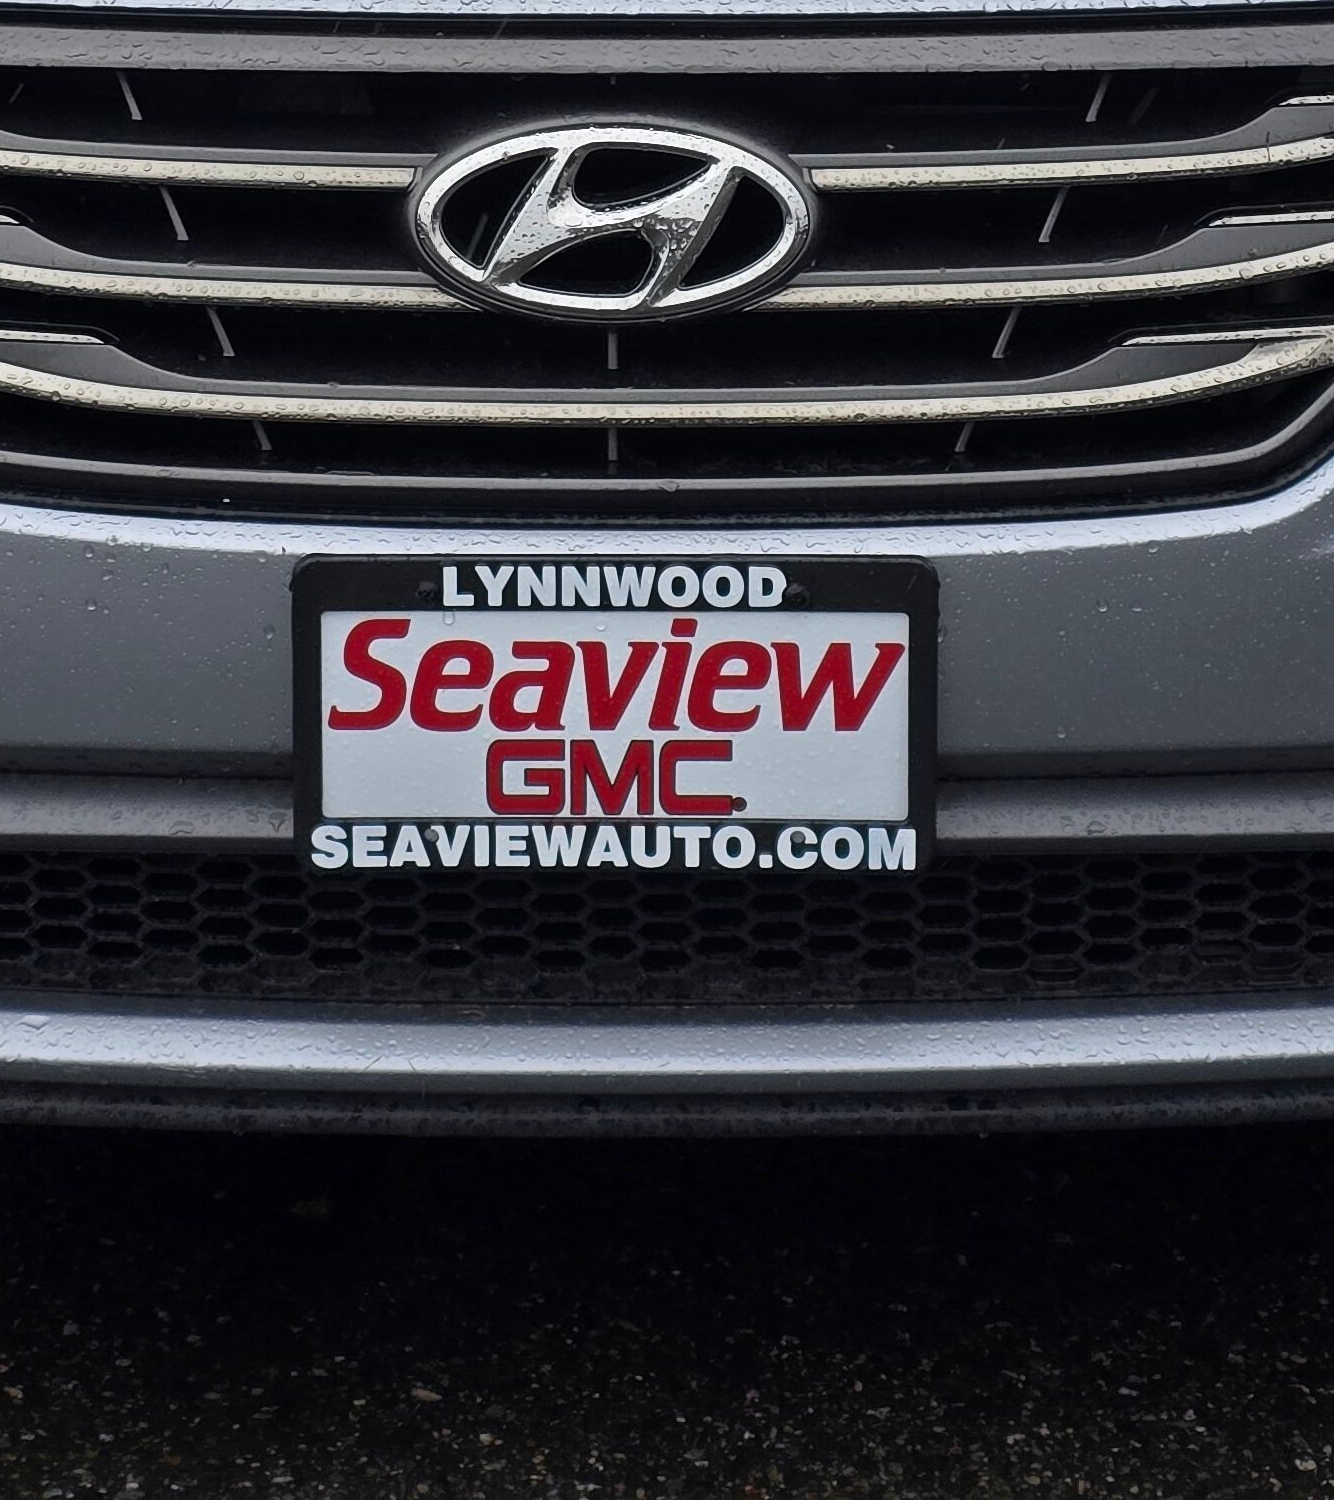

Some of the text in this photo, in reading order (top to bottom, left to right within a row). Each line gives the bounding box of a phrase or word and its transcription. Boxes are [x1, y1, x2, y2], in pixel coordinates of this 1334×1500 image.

[442, 565, 787, 608] LYNNWOOD
[327, 617, 907, 733] Seaview
[485, 739, 735, 816] GMC
[310, 824, 917, 871] SEAVIEWAUTO.COM
